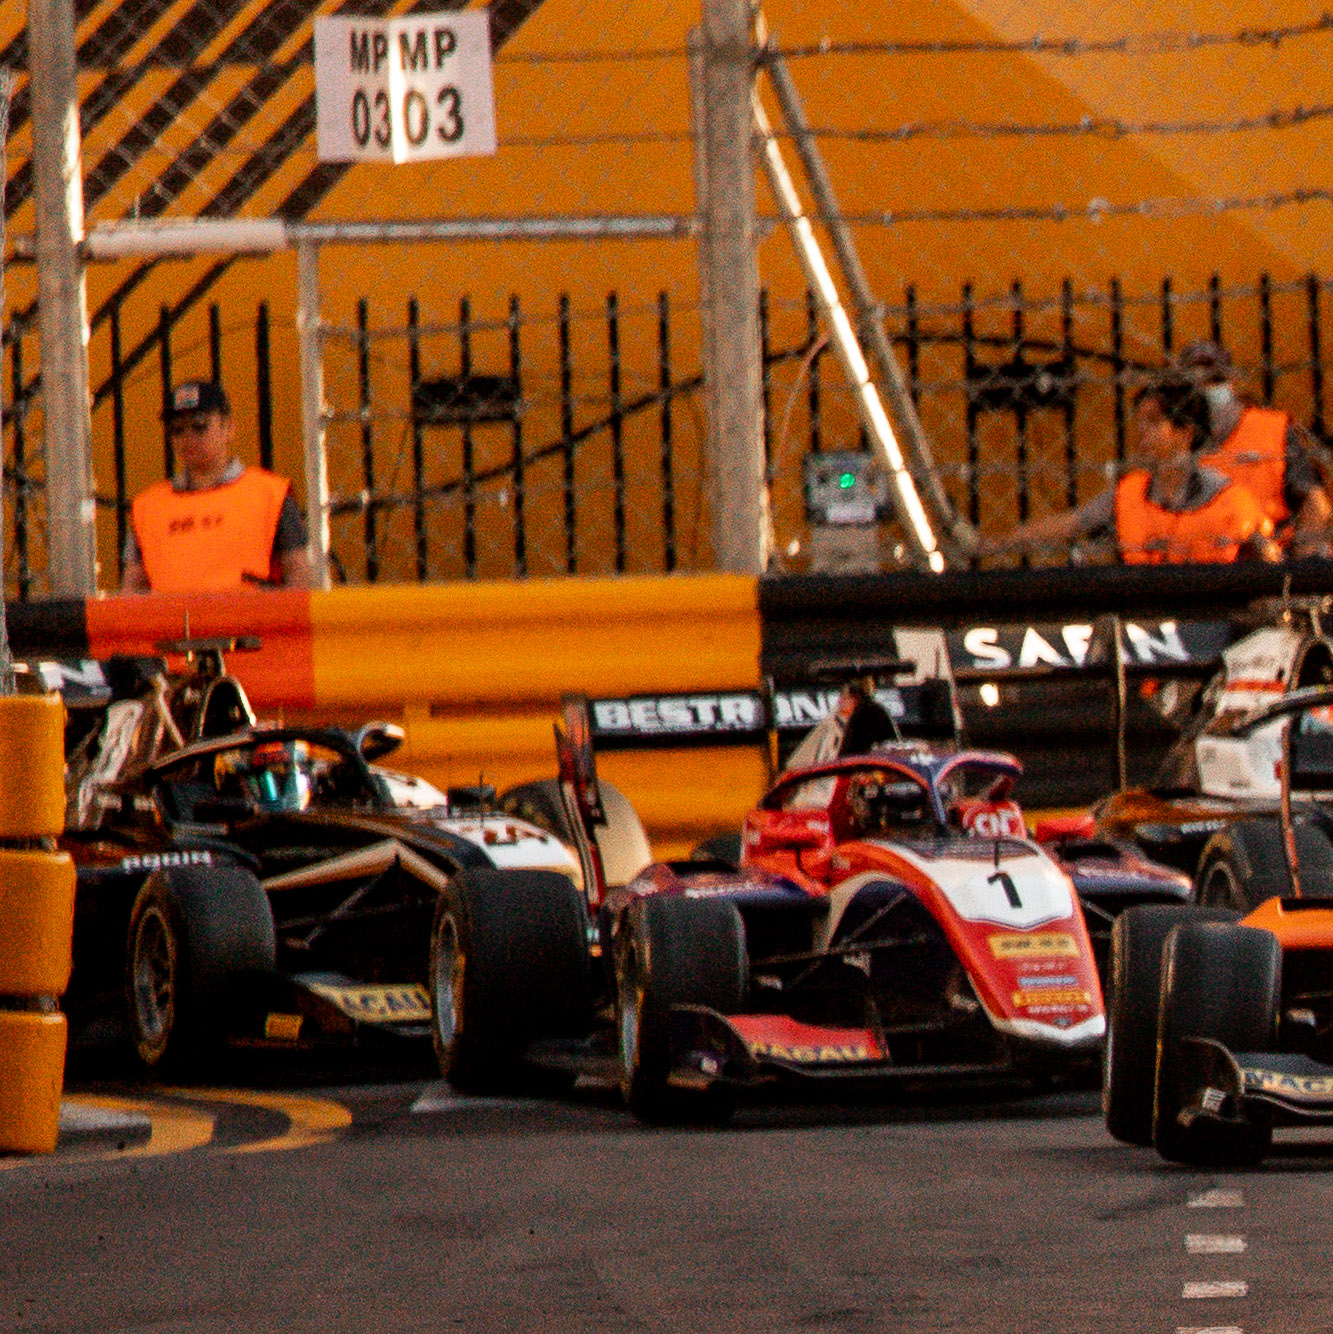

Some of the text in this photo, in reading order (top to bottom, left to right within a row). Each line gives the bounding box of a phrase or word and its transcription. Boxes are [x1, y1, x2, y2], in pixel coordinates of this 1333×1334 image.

[350, 28, 458, 73] MP MP
[352, 86, 465, 148] 03 03
[962, 620, 1190, 668] SAFN
[986, 870, 1023, 909] 1
